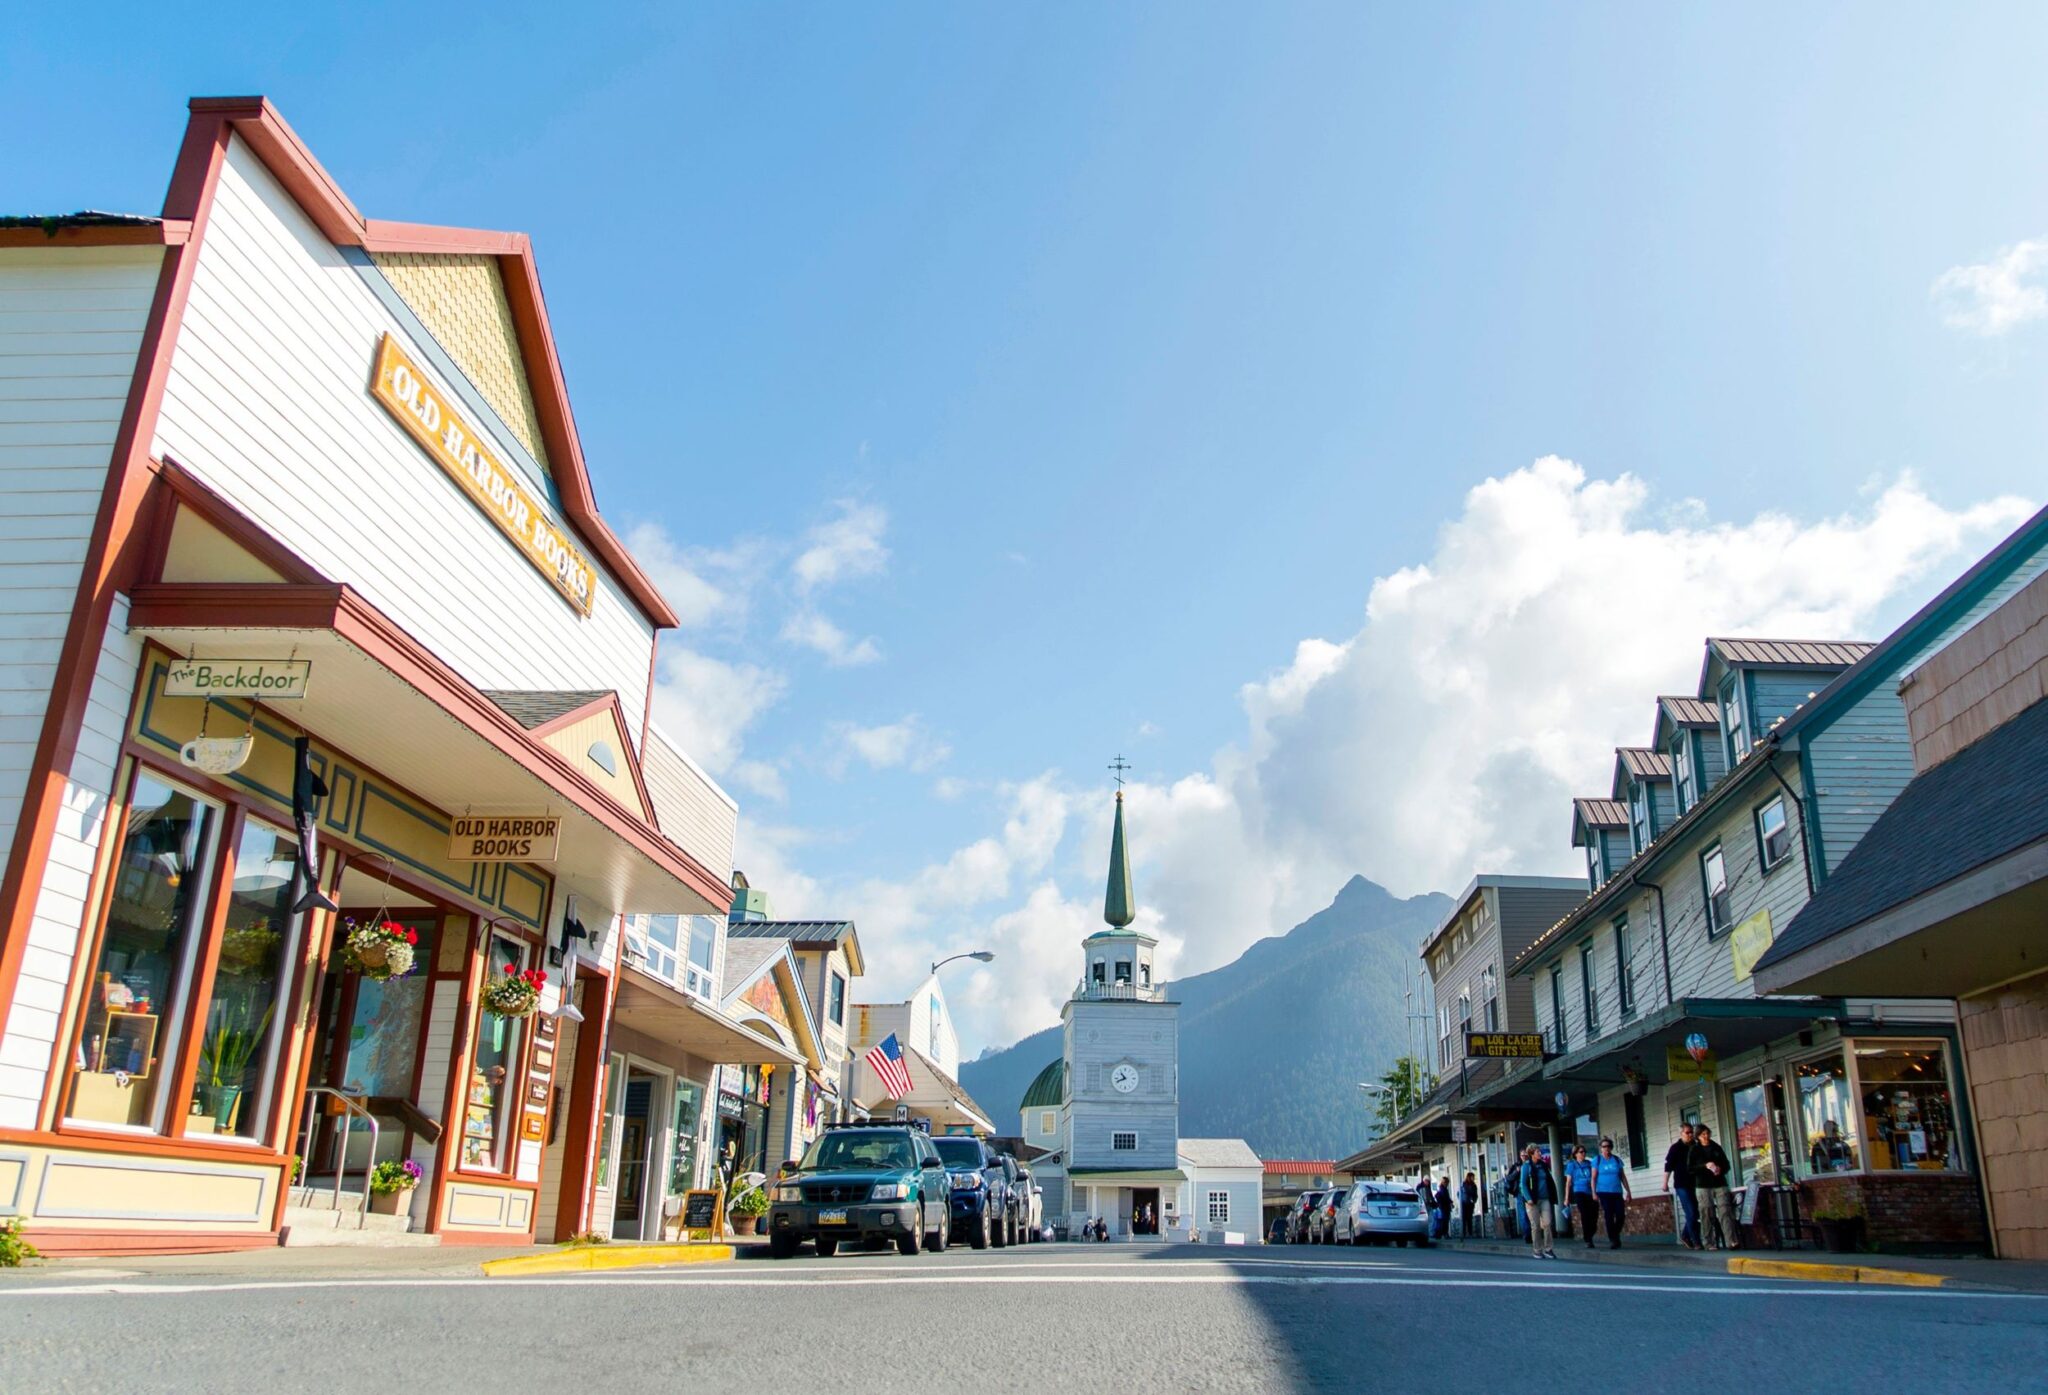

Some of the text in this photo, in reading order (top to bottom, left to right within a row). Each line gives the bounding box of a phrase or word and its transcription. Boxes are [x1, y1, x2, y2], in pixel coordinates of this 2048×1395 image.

[393, 365, 589, 598] OLD HARBOR BOOKS
[171, 666, 299, 688] The Backdoor
[455, 820, 556, 836] OLD HARBOR
[472, 839, 531, 856] BOOKS
[1487, 1034, 1541, 1045] LOG CACHE
[1488, 1045, 1518, 1056] GIFTS
